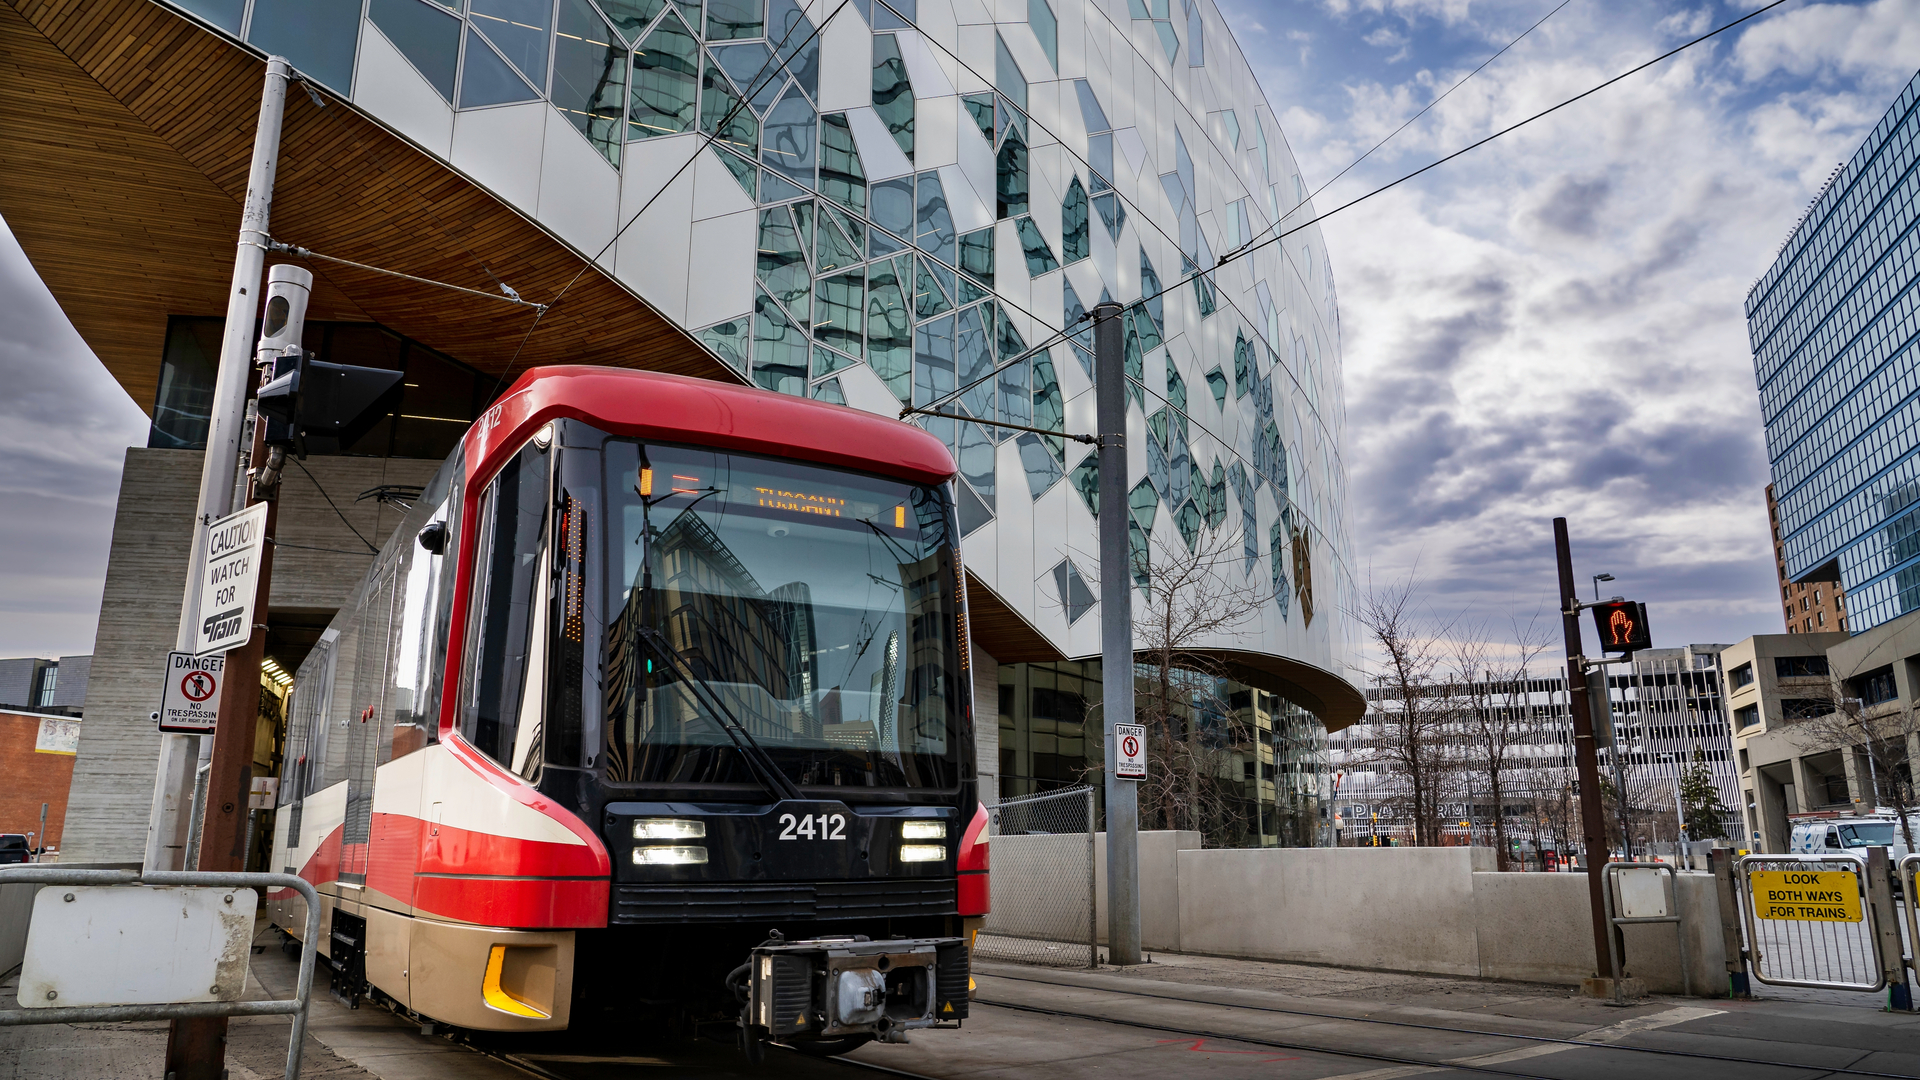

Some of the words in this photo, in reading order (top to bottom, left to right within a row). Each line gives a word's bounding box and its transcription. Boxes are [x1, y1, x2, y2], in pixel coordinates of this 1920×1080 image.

[477, 404, 502, 439] 2412
[210, 517, 259, 555] CAUTION
[211, 556, 250, 585] WATCH
[215, 585, 236, 607] FOR
[189, 702, 202, 710] NO
[167, 708, 217, 719] TRESPASSIN
[1118, 726, 1143, 737] DANGER
[778, 813, 847, 840] 2412
[1783, 874, 1820, 885] LOOK
[1768, 890, 1803, 901] BOTH
[1806, 891, 1843, 902] WAYS
[1770, 906, 1795, 917] FOR
[1797, 907, 1846, 919] TRAINS
